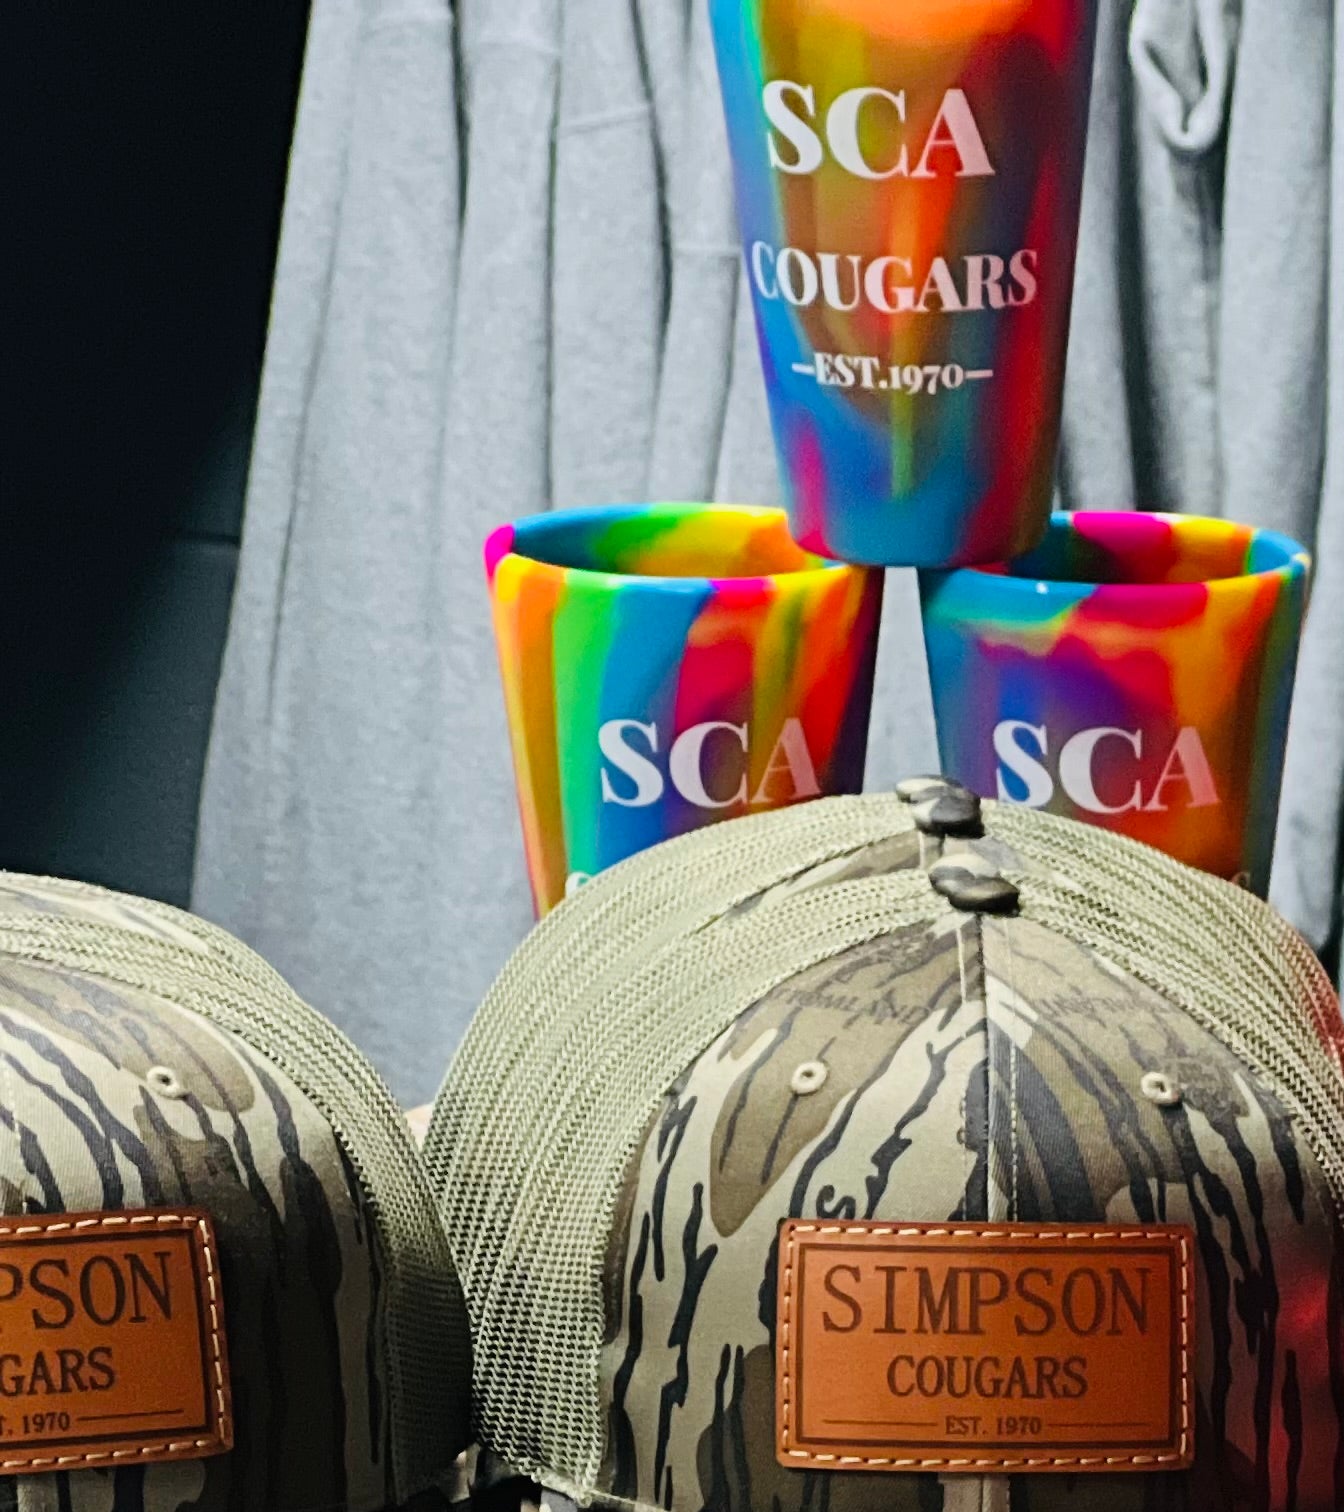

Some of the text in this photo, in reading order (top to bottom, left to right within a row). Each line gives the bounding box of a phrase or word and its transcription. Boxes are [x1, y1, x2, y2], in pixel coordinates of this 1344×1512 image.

[762, 80, 996, 180] SCA
[752, 240, 1038, 314] COUGARS
[598, 717, 822, 808] SCA
[993, 719, 1219, 813] SCA
[821, 1263, 1151, 1337] SIMPSON
[886, 1354, 1088, 1400] COUGARS
[22, 1411, 71, 1434] 1970
[944, 1416, 1043, 1435] EST. 1970
